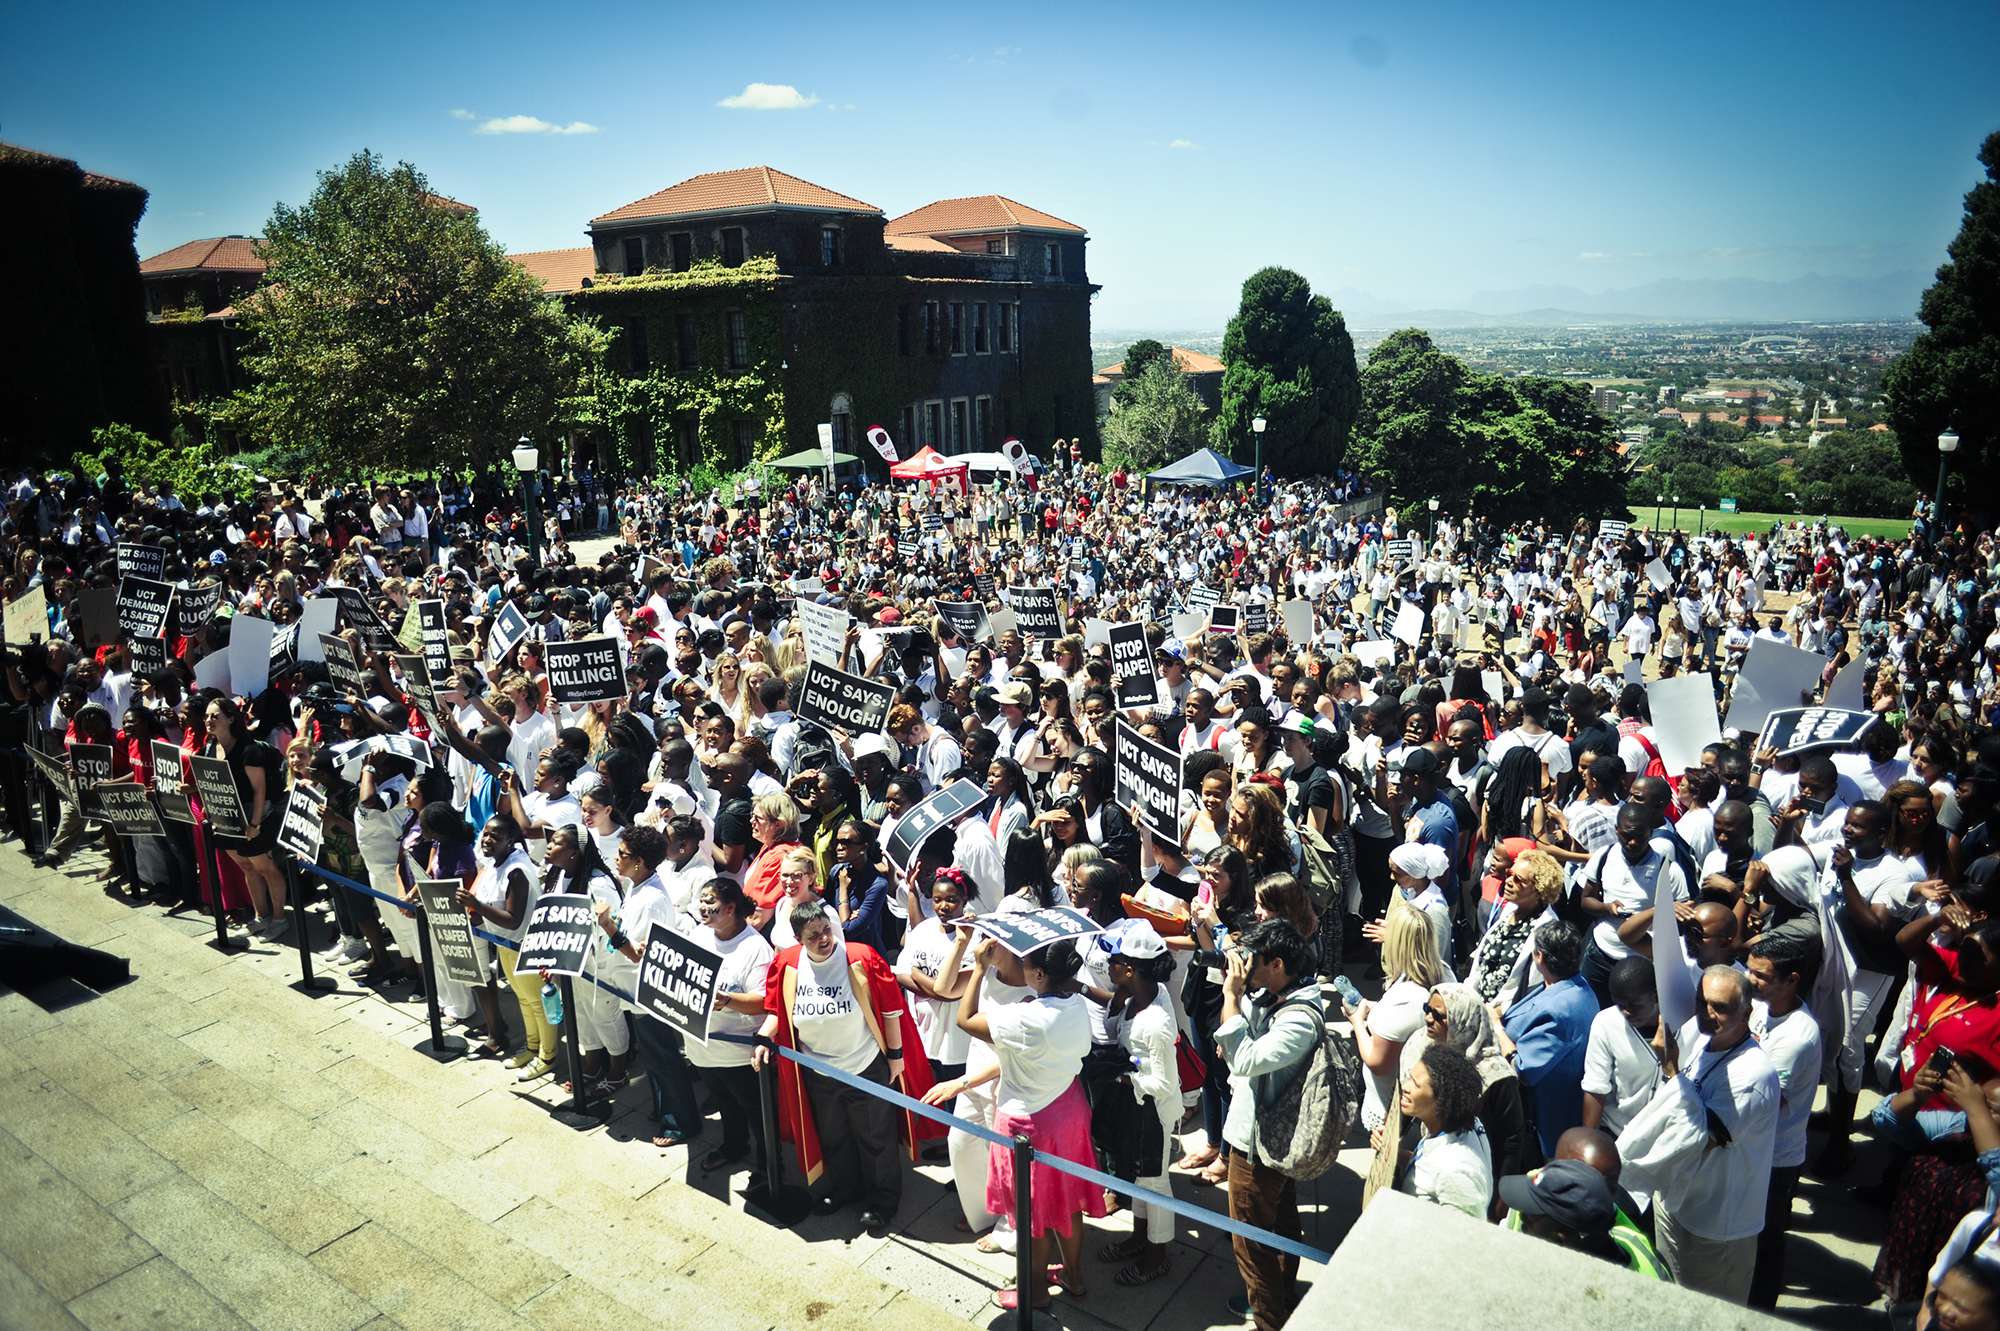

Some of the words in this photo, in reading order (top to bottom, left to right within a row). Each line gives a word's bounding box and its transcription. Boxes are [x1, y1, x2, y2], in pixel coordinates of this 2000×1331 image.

[882, 448, 896, 458] SRC
[1018, 460, 1030, 472] SRC
[120, 548, 131, 558] UCT
[133, 549, 161, 560] SAYS:
[119, 560, 159, 573] ENOUGH!
[136, 589, 156, 600] UCT
[185, 592, 218, 607] SAYS:
[1024, 596, 1053, 608] SAYS:
[120, 597, 166, 614] DEMANDS
[342, 596, 363, 609] HOW
[120, 608, 128, 618] A
[130, 610, 160, 624] SAFER
[349, 610, 374, 623] MANY
[952, 616, 975, 624] Brian
[1015, 612, 1057, 626] ENOUGH!
[119, 619, 157, 634] SOCIETY
[322, 642, 336, 657] UCT
[1114, 639, 1143, 660] STOP
[132, 659, 162, 674] UGH!
[550, 654, 580, 668] STOP
[584, 650, 615, 665] THE
[328, 663, 360, 685] ENOUGH!
[1115, 658, 1151, 678] RAPE!
[551, 666, 618, 686] KILLING!
[811, 669, 841, 692] UCT
[842, 684, 886, 708] SAYS:
[806, 688, 881, 729] ENOUGH!
[1787, 709, 1826, 748] RAPE!
[1814, 711, 1849, 739] STOP
[78, 760, 110, 775] STOP
[157, 758, 179, 778] STOP
[1118, 734, 1139, 764] UCT
[1140, 751, 1176, 787] SAYS:
[204, 770, 219, 780] UCT
[157, 776, 184, 796] RAPE
[198, 780, 235, 794] DEMANDS
[1118, 762, 1176, 818] ENOUGH!
[102, 792, 120, 804] UCT
[123, 792, 146, 803] SAYS
[204, 793, 210, 802] A
[211, 795, 236, 806] SAFER
[292, 791, 307, 810] UCT
[109, 808, 156, 821] ENOUGH!
[208, 804, 238, 818] SOCIETY
[286, 811, 320, 843] ENOUGH!
[433, 897, 449, 909] UCT
[429, 913, 467, 926] DEMANDS
[531, 908, 548, 925] UCT
[548, 906, 592, 926] SAYS:
[1035, 910, 1084, 933] SAYS:
[437, 929, 443, 938] A
[443, 930, 468, 942] SAFER
[524, 931, 586, 953] ENOUGH!
[441, 945, 472, 959] SOCIETY
[649, 940, 684, 968] STOP
[686, 956, 713, 989] THE
[644, 962, 708, 1015] KILLING!
[796, 985, 813, 997] We
[817, 985, 842, 998] say:
[792, 1000, 852, 1016] ENOUGH!
